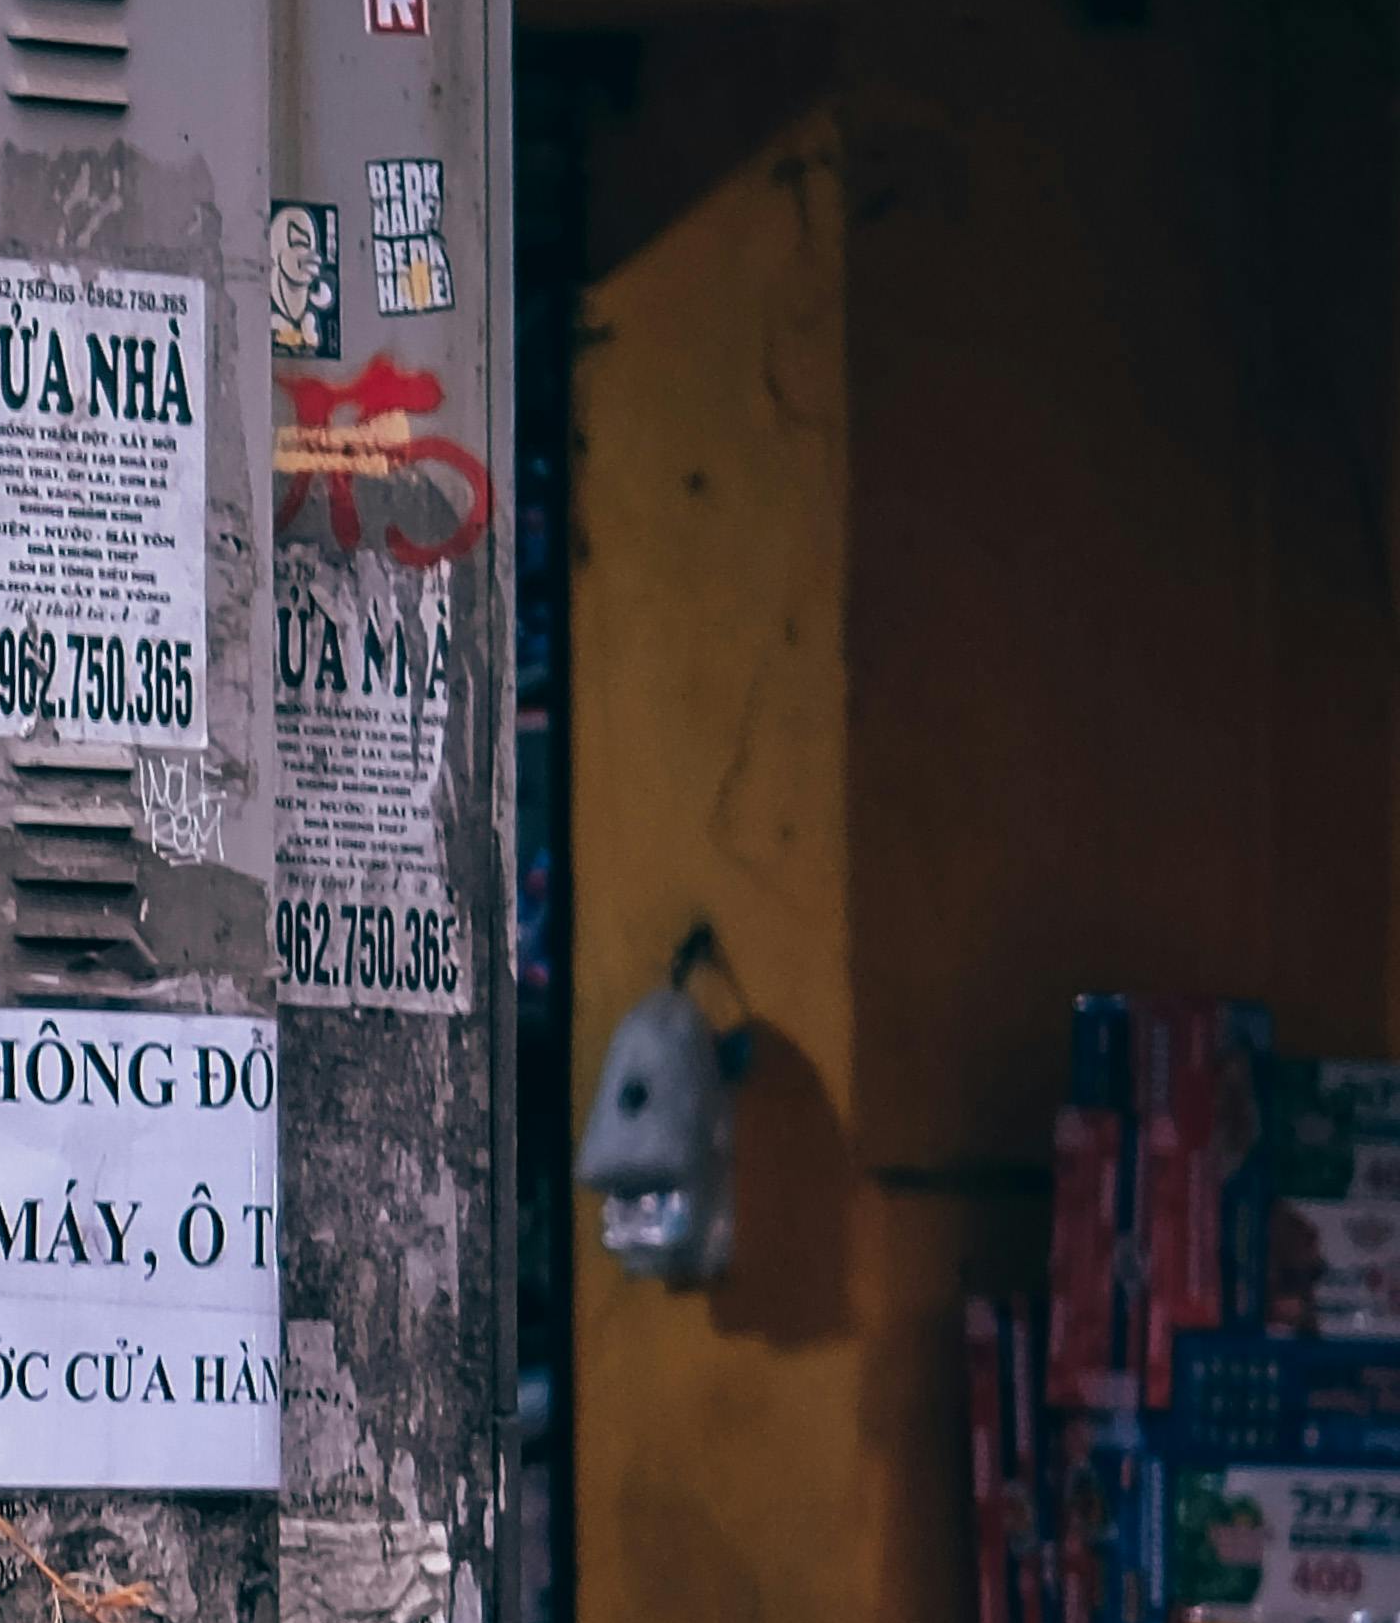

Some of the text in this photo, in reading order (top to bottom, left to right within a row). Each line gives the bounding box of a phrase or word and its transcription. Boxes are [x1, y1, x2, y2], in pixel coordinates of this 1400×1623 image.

[86, 316, 193, 426] NHÀ
[275, 585, 348, 696] ỬA
[275, 899, 459, 994] 962.750.365
[177, 1180, 226, 1268] Ô
[242, 1204, 275, 1269] T
[64, 1338, 176, 1404] CỬA
[192, 1340, 279, 1405] HÀN
